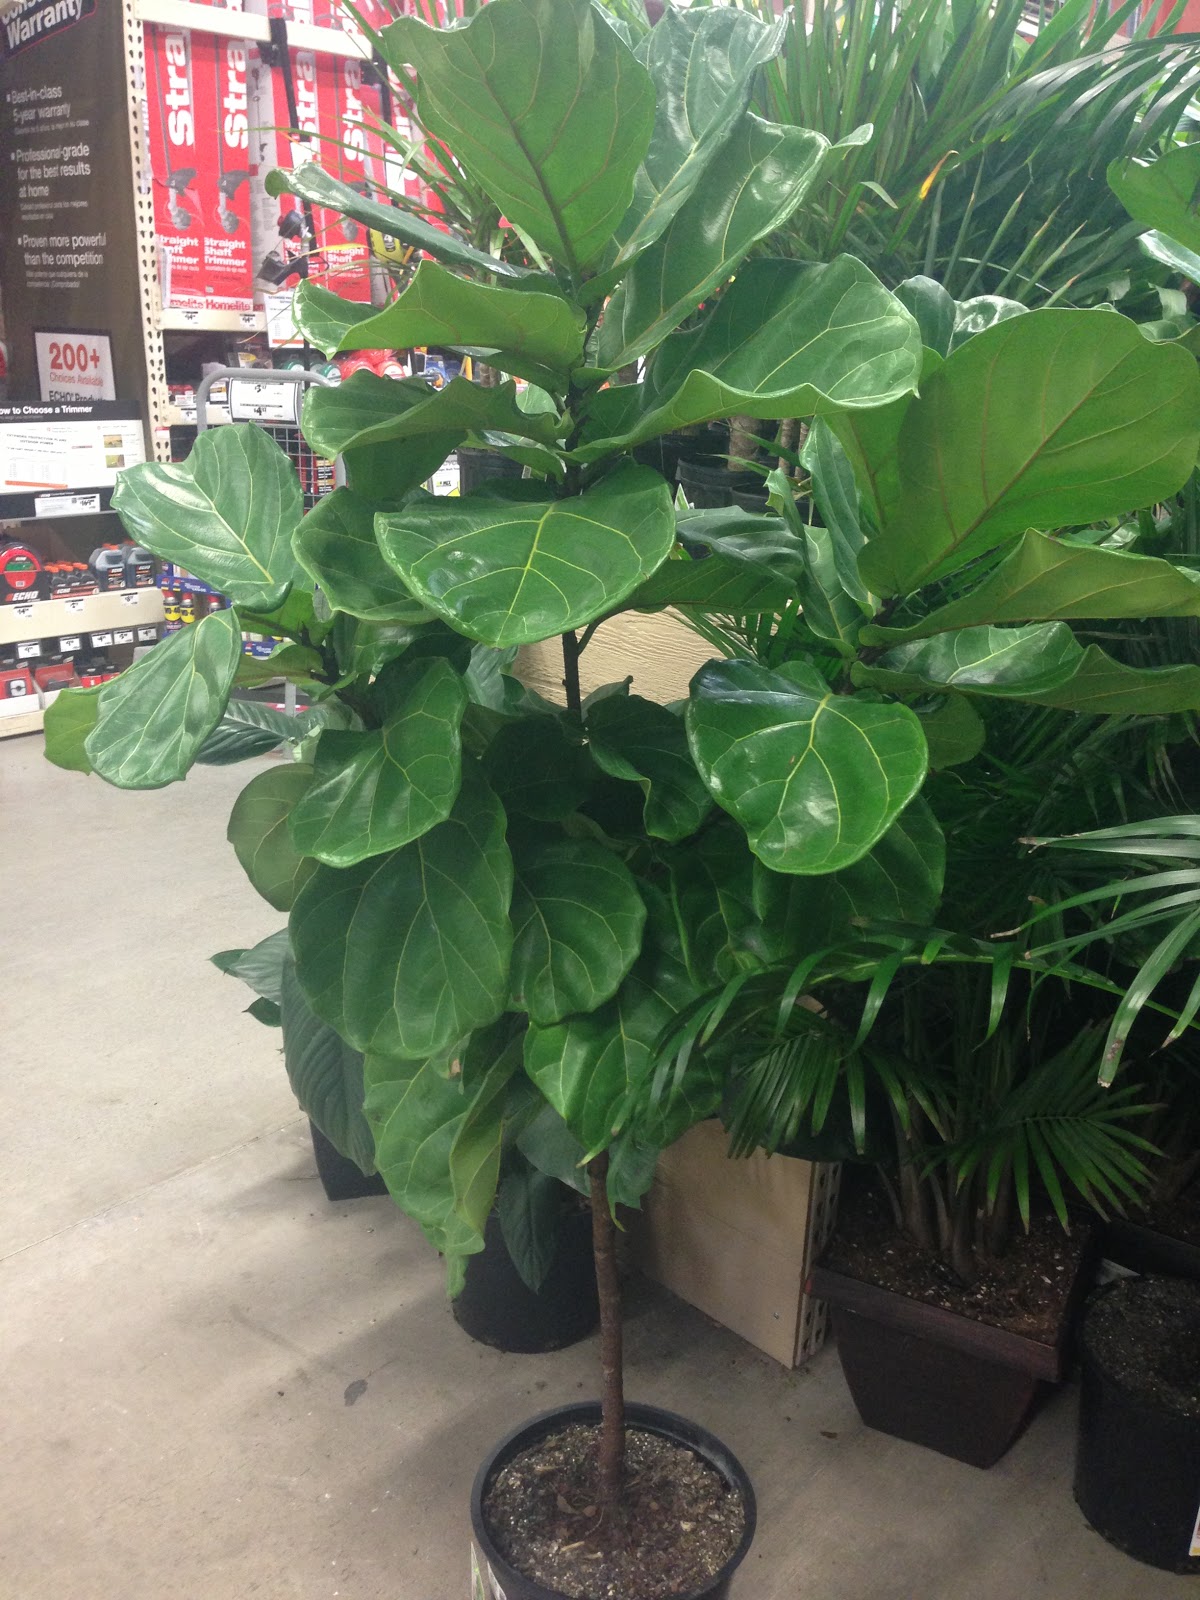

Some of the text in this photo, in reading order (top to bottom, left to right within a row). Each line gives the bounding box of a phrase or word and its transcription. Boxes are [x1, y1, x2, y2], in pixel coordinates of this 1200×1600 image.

[7, 0, 82, 49] Warranty
[11, 86, 63, 104] Best-in-class
[165, 35, 194, 146] Stra
[223, 41, 248, 149] Stra
[13, 102, 71, 124] 5-year warranty
[342, 60, 364, 161] Stra
[16, 143, 90, 162] Professional-grade
[17, 161, 91, 180] for the best results
[19, 184, 49, 198] at home
[22, 232, 107, 250] Proven more powerful
[159, 235, 199, 247] traight
[204, 236, 246, 249] Straight
[24, 251, 104, 267] than the competition
[204, 246, 232, 257] Shaft
[327, 254, 352, 263] Shaft
[204, 256, 247, 266] Trimmer
[206, 299, 251, 311] Homelite
[49, 342, 100, 372] 200+
[49, 372, 104, 387] Choices Available
[12, 406, 21, 415] to
[22, 405, 53, 414] Choose
[61, 405, 93, 414] Trimmer
[12, 590, 39, 602] ECHO
